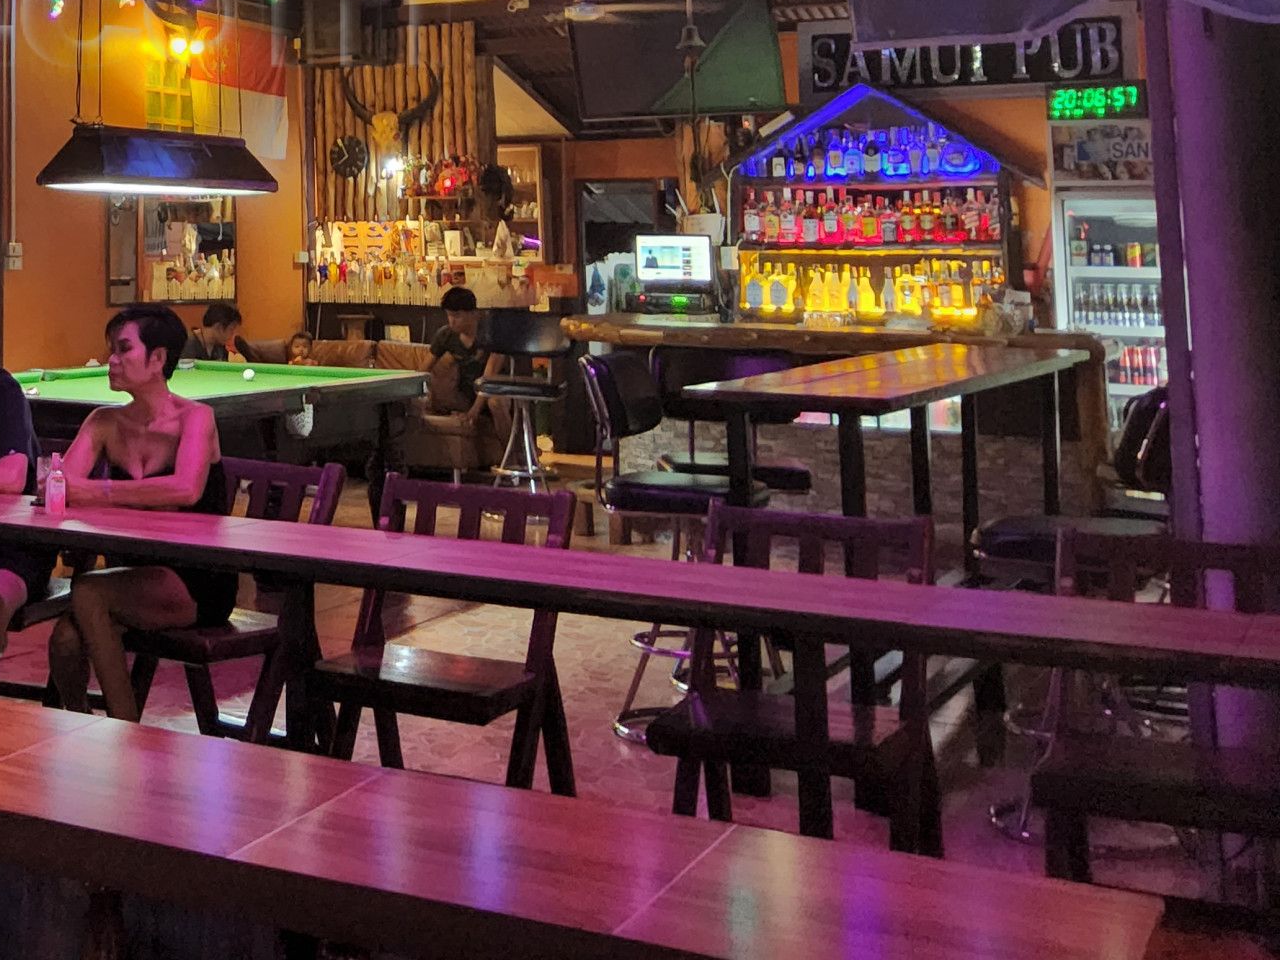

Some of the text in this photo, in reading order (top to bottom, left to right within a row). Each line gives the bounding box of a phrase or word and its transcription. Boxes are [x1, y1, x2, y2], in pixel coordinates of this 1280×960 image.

[812, 21, 1120, 88] SAMUI PUB
[1051, 85, 1138, 109] 20:06:57
